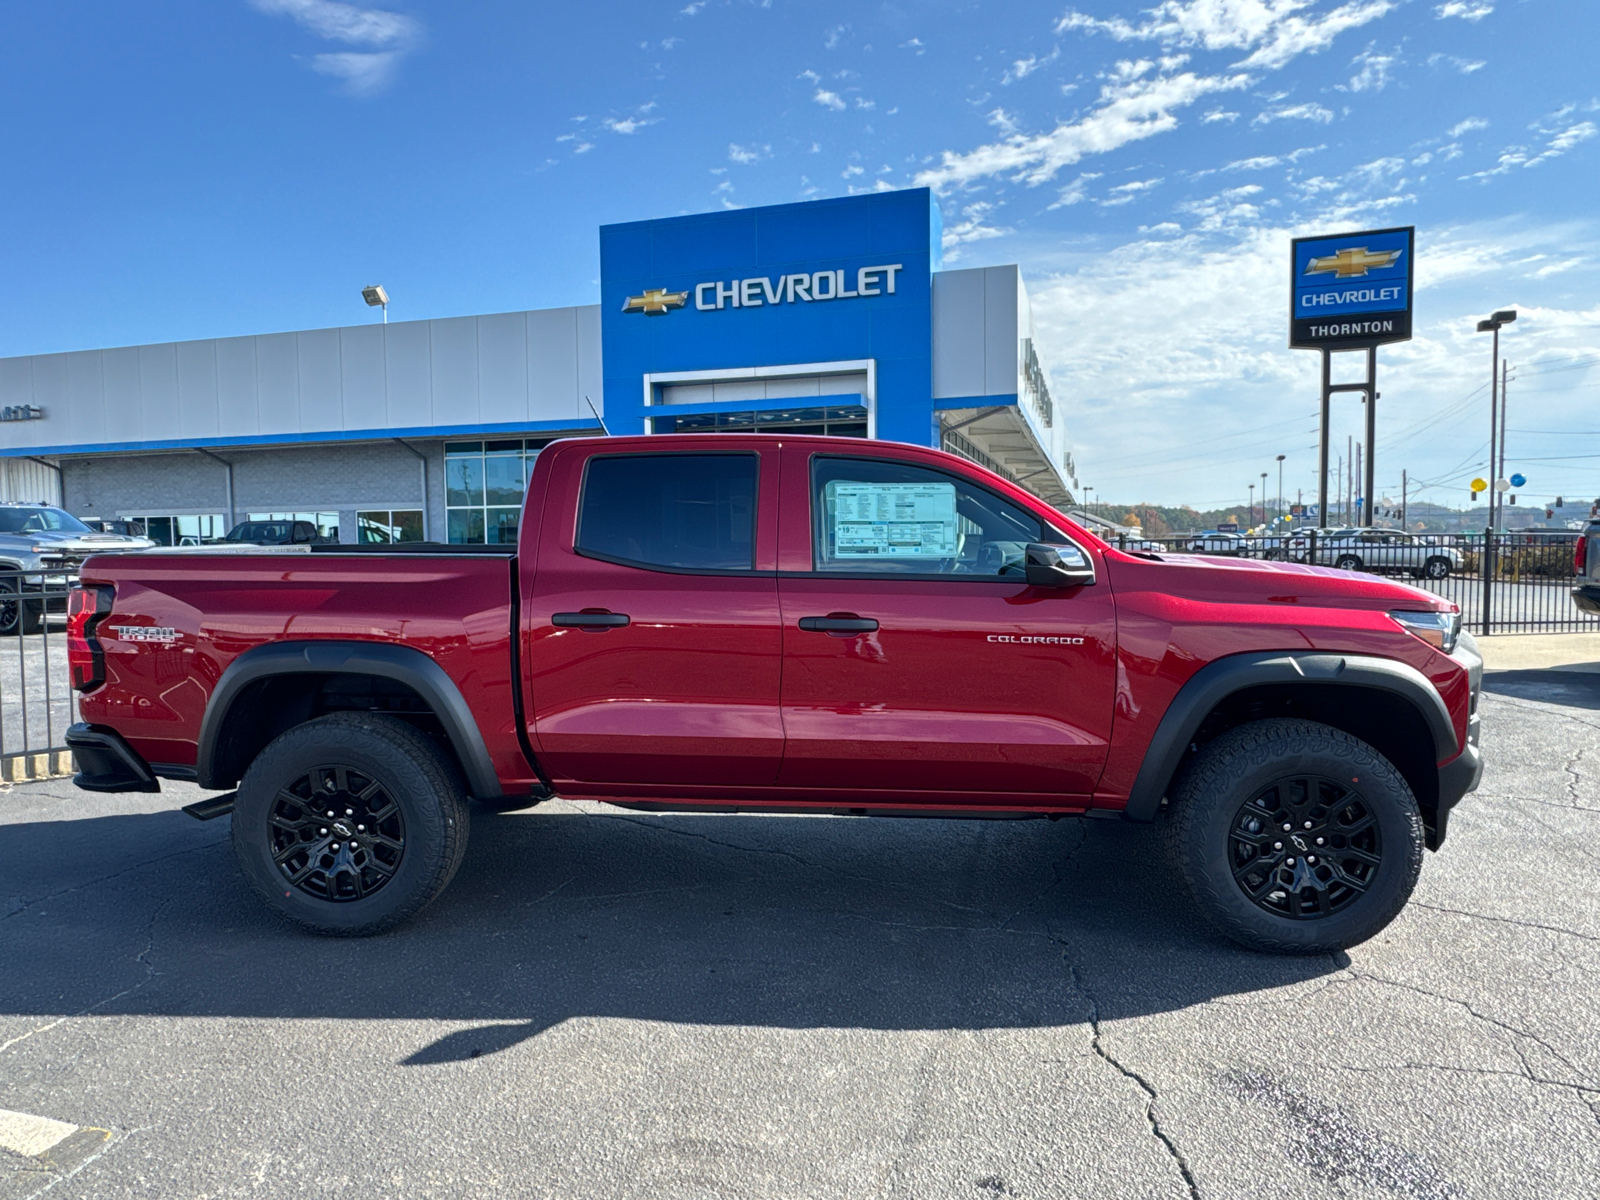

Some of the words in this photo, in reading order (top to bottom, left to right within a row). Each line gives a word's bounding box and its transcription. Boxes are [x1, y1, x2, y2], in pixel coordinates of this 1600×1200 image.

[695, 263, 903, 311] CHEVROLET
[1302, 287, 1402, 307] CHEVROLET
[1310, 320, 1393, 337] THORNTON
[108, 625, 184, 638] TRAIL
[118, 634, 175, 643] BOSS
[987, 635, 1084, 645] COLORADO
